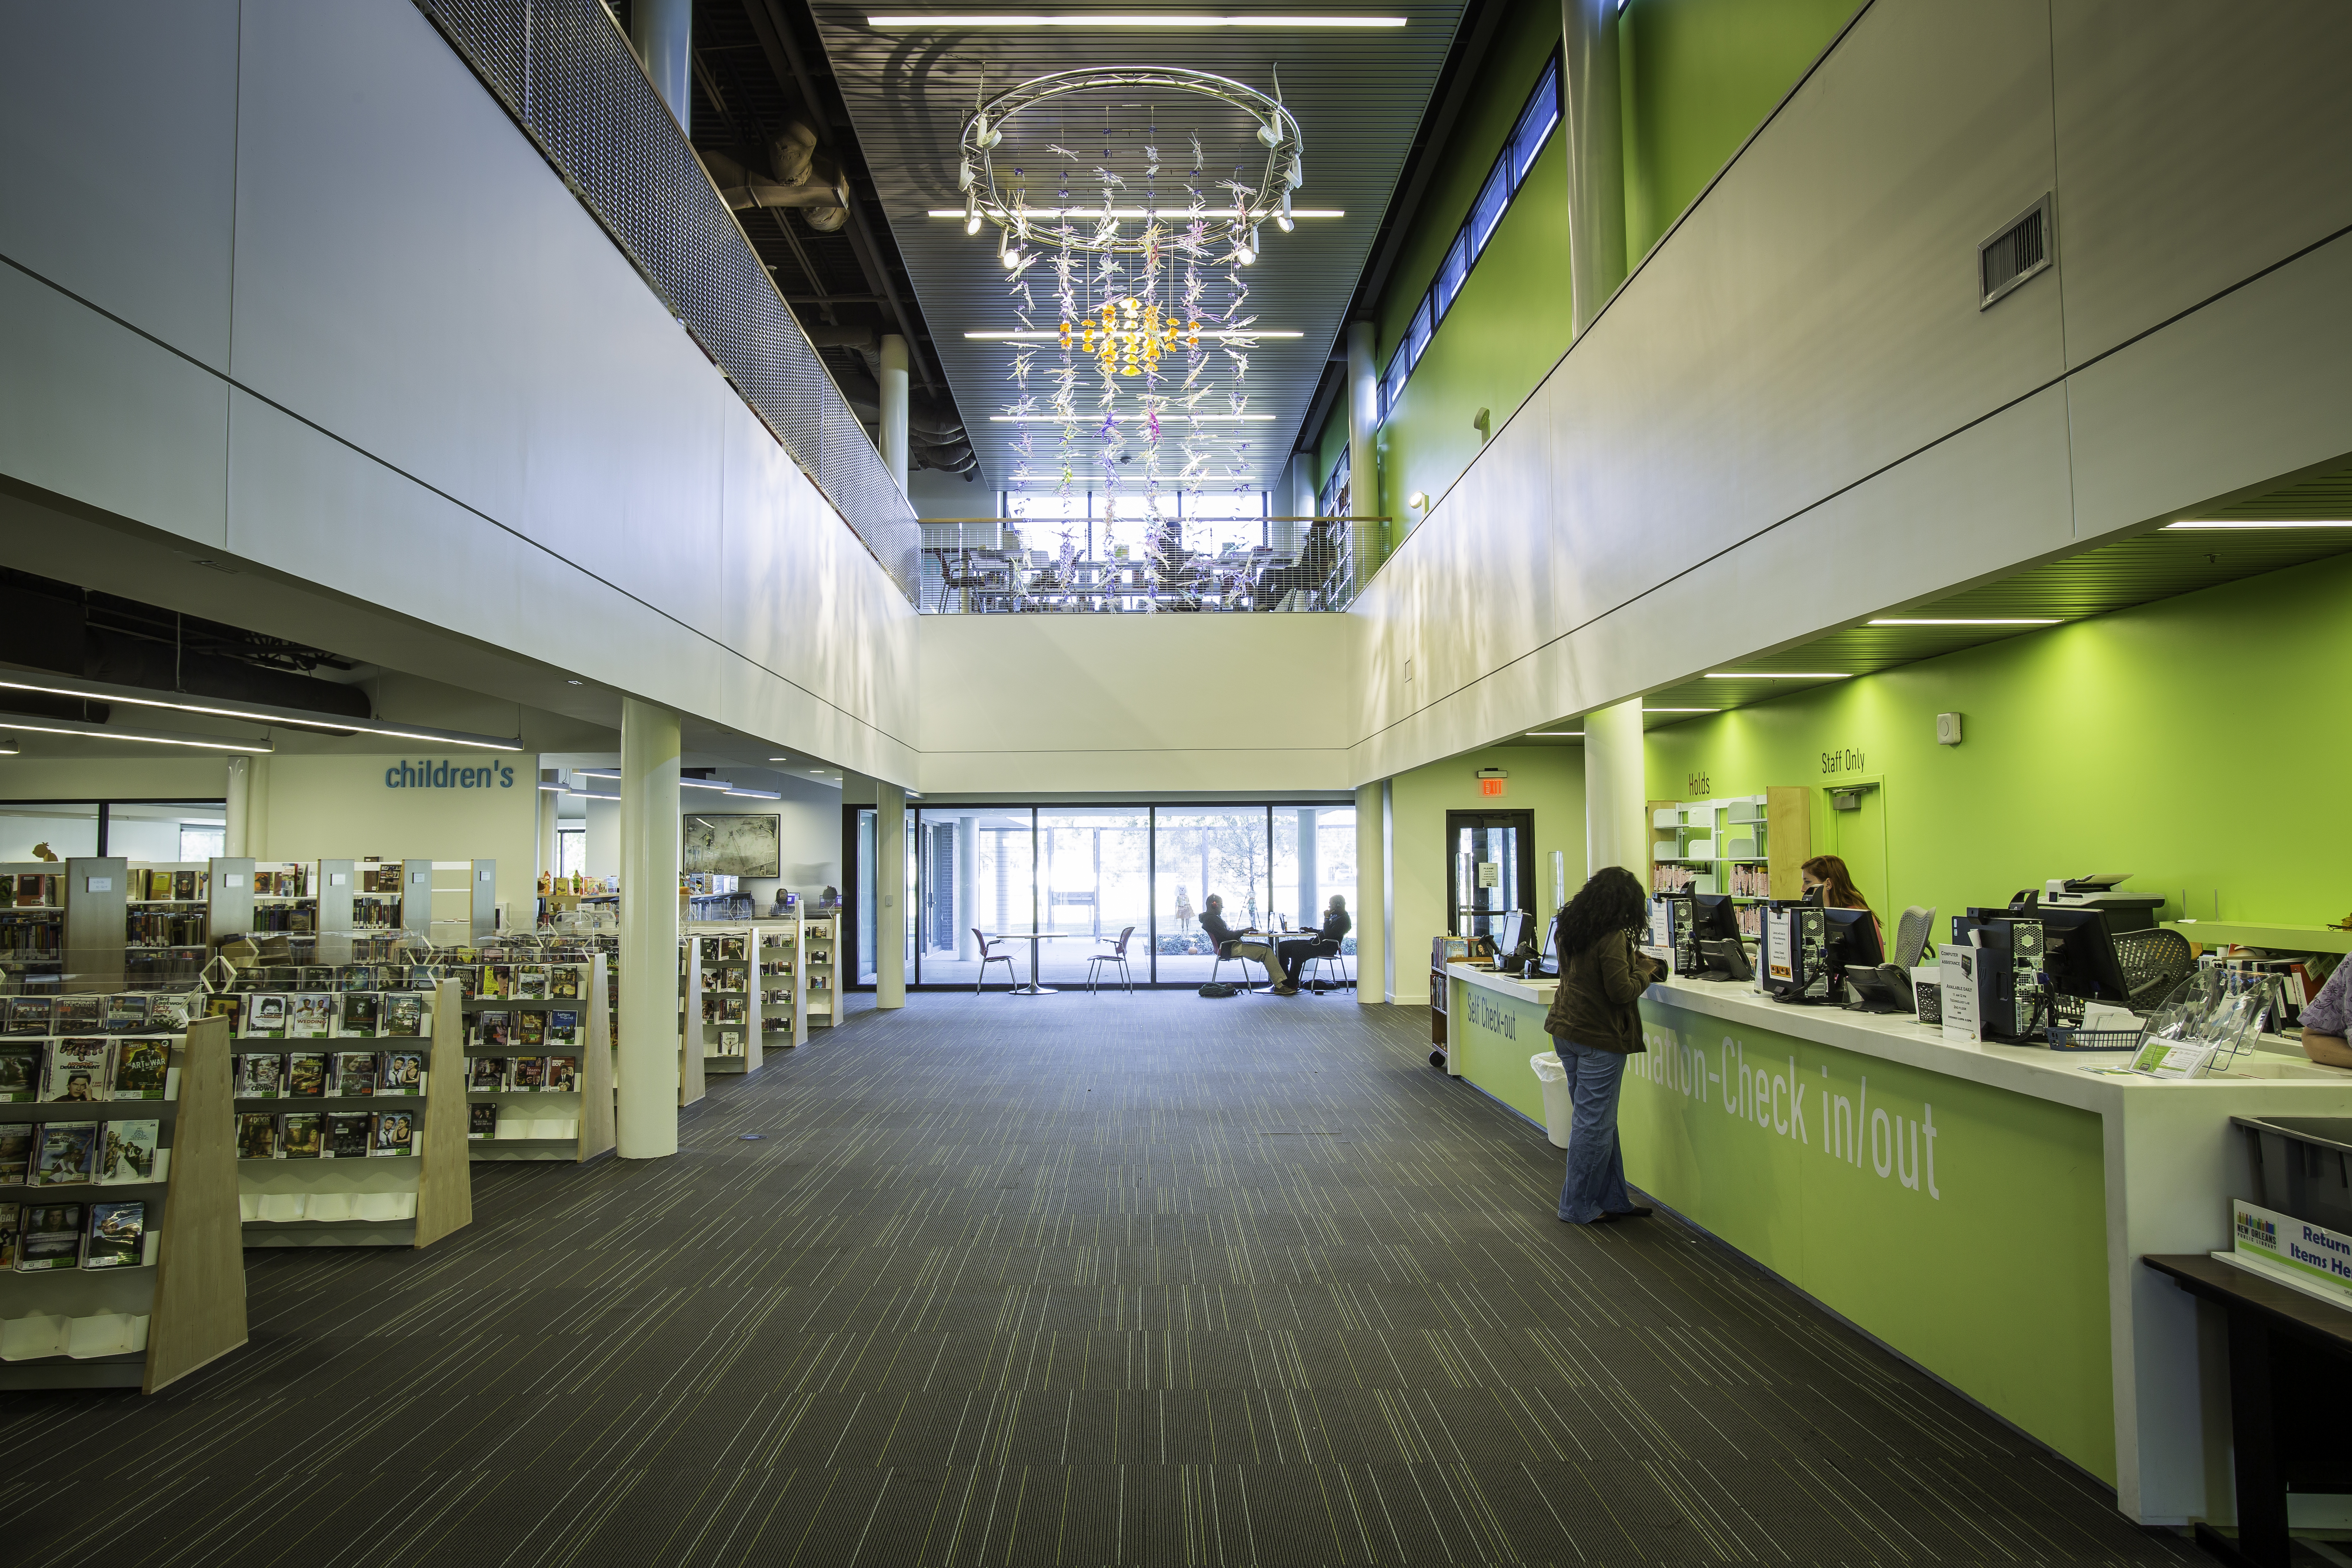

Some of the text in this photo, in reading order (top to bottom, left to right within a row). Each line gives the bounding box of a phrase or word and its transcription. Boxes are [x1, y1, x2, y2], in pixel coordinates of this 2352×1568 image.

[385, 760, 513, 788] children's
[1822, 748, 1865, 774] Staff Only
[1483, 779, 1503, 796] EXIT
[1689, 772, 1710, 796] Holds
[1468, 992, 1515, 1041] Self Check-out
[132, 1061, 144, 1069] ART
[1822, 1065, 1939, 1200] in/out
[2237, 1224, 2276, 1245] NEW ORLEANS
[2237, 1233, 2276, 1250] PUBLIC LIBRARY
[2303, 1226, 2350, 1255] Return
[2290, 1243, 2352, 1279] Items He
